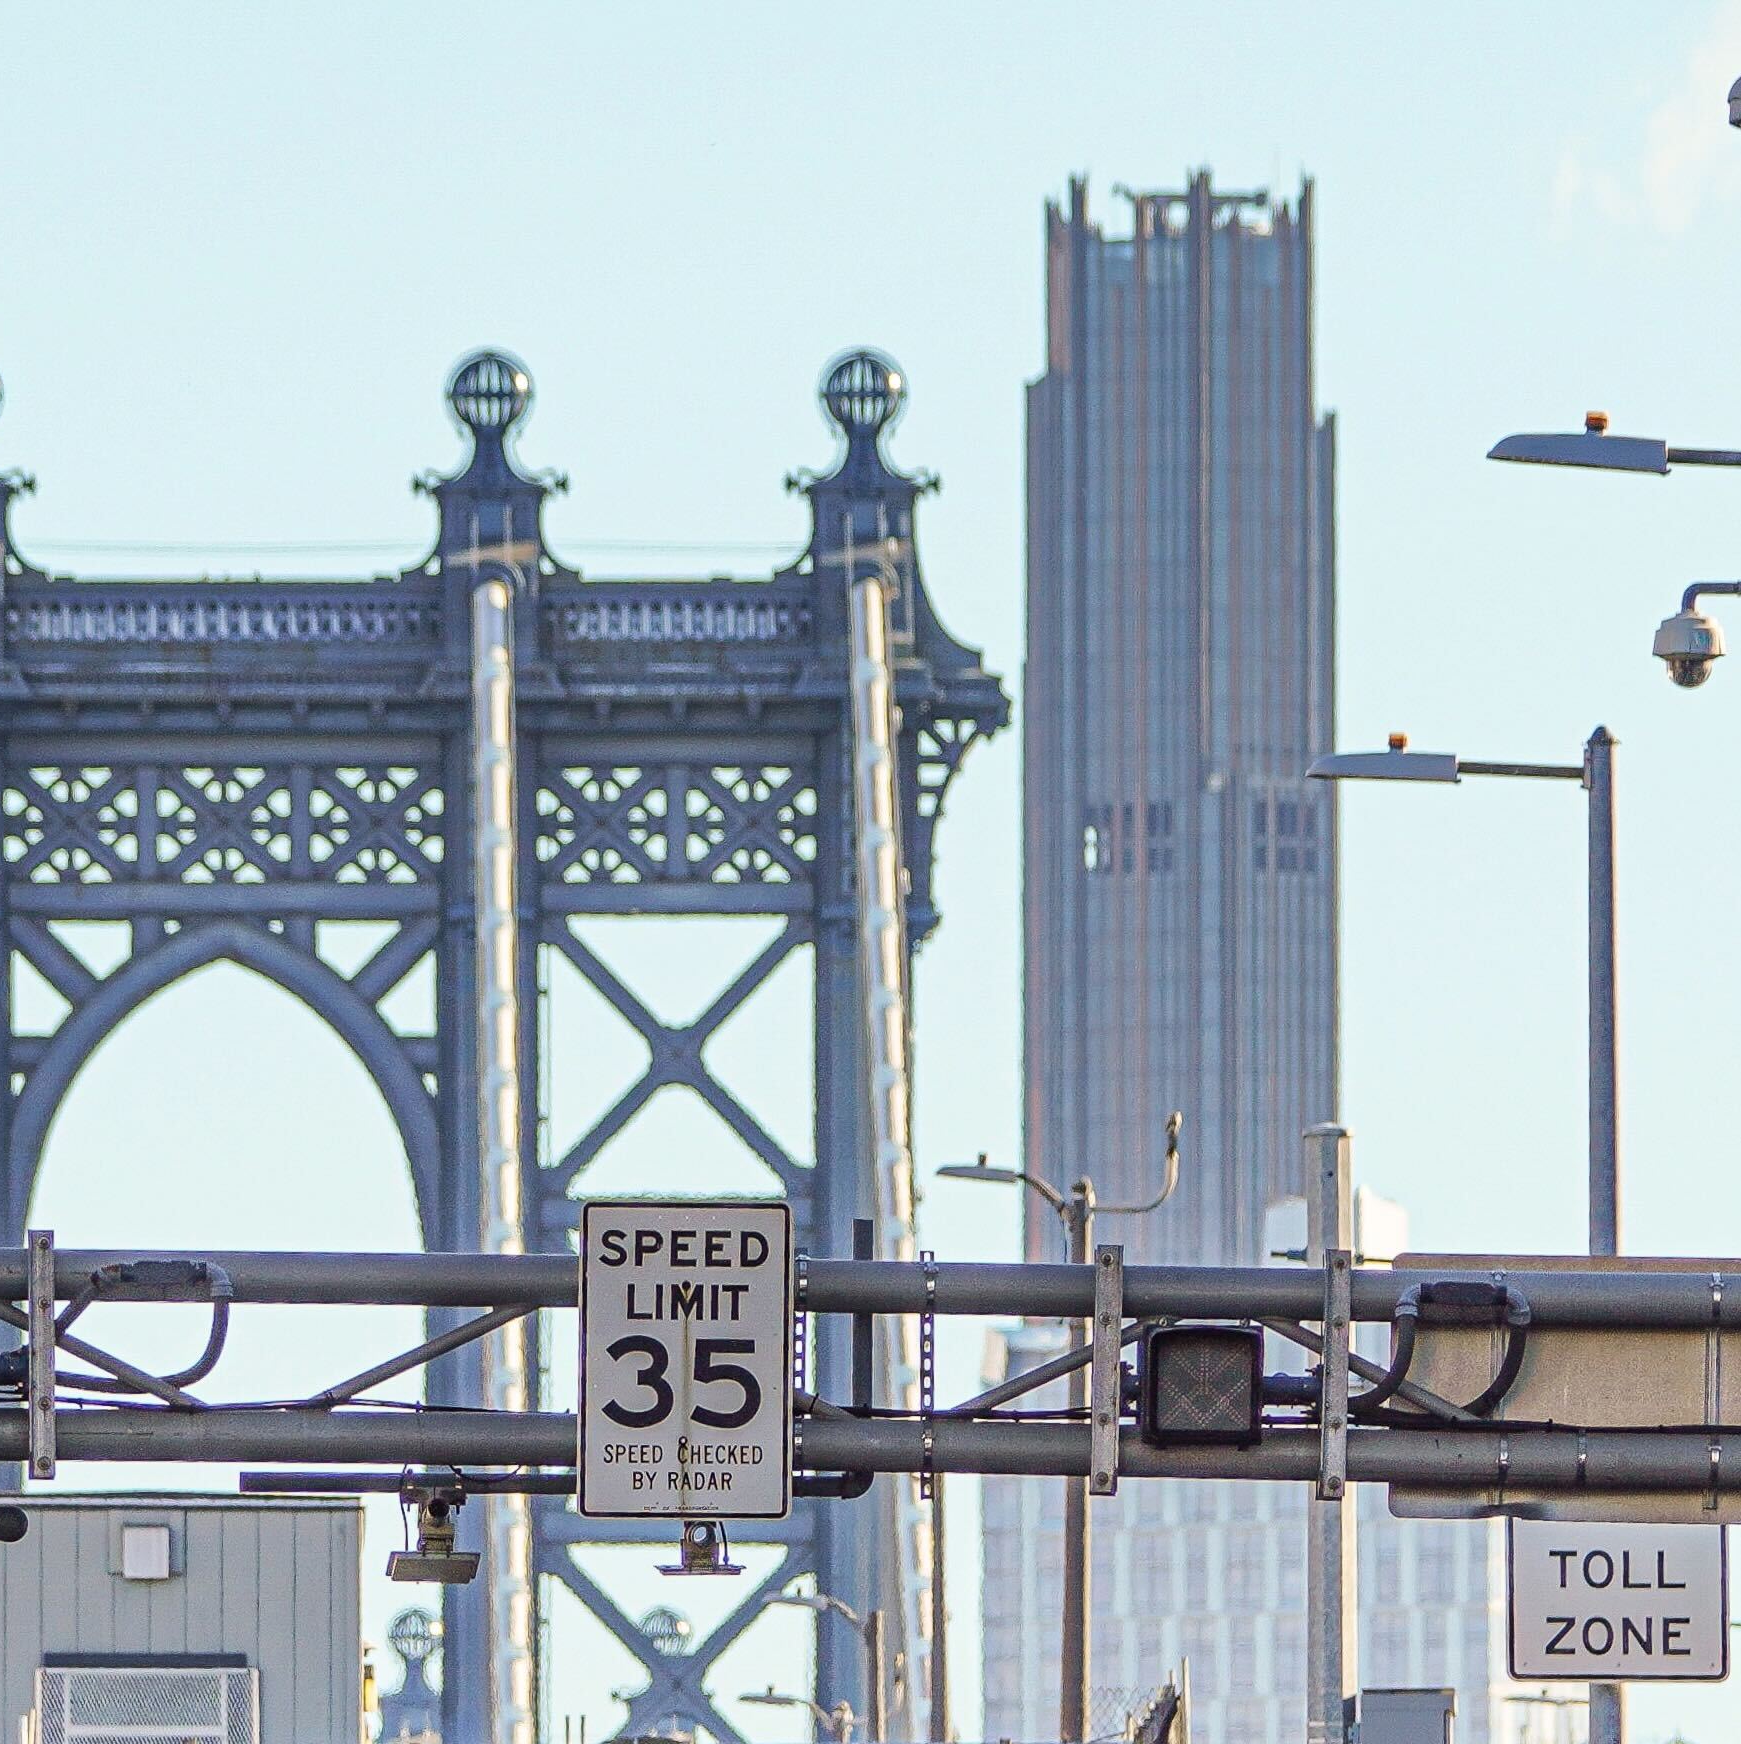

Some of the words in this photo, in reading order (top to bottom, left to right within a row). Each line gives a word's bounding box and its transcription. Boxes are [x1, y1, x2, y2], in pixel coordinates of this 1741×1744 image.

[598, 1230, 770, 1268] SPEED
[626, 1283, 750, 1321] LIMIT
[601, 1334, 762, 1429] 35
[603, 1444, 664, 1464] SPEED
[677, 1444, 763, 1465] CHECKED
[632, 1472, 657, 1490] BY
[667, 1472, 733, 1491] RADAR
[1549, 1549, 1687, 1589] TOLL
[1545, 1616, 1691, 1656] ZONE
